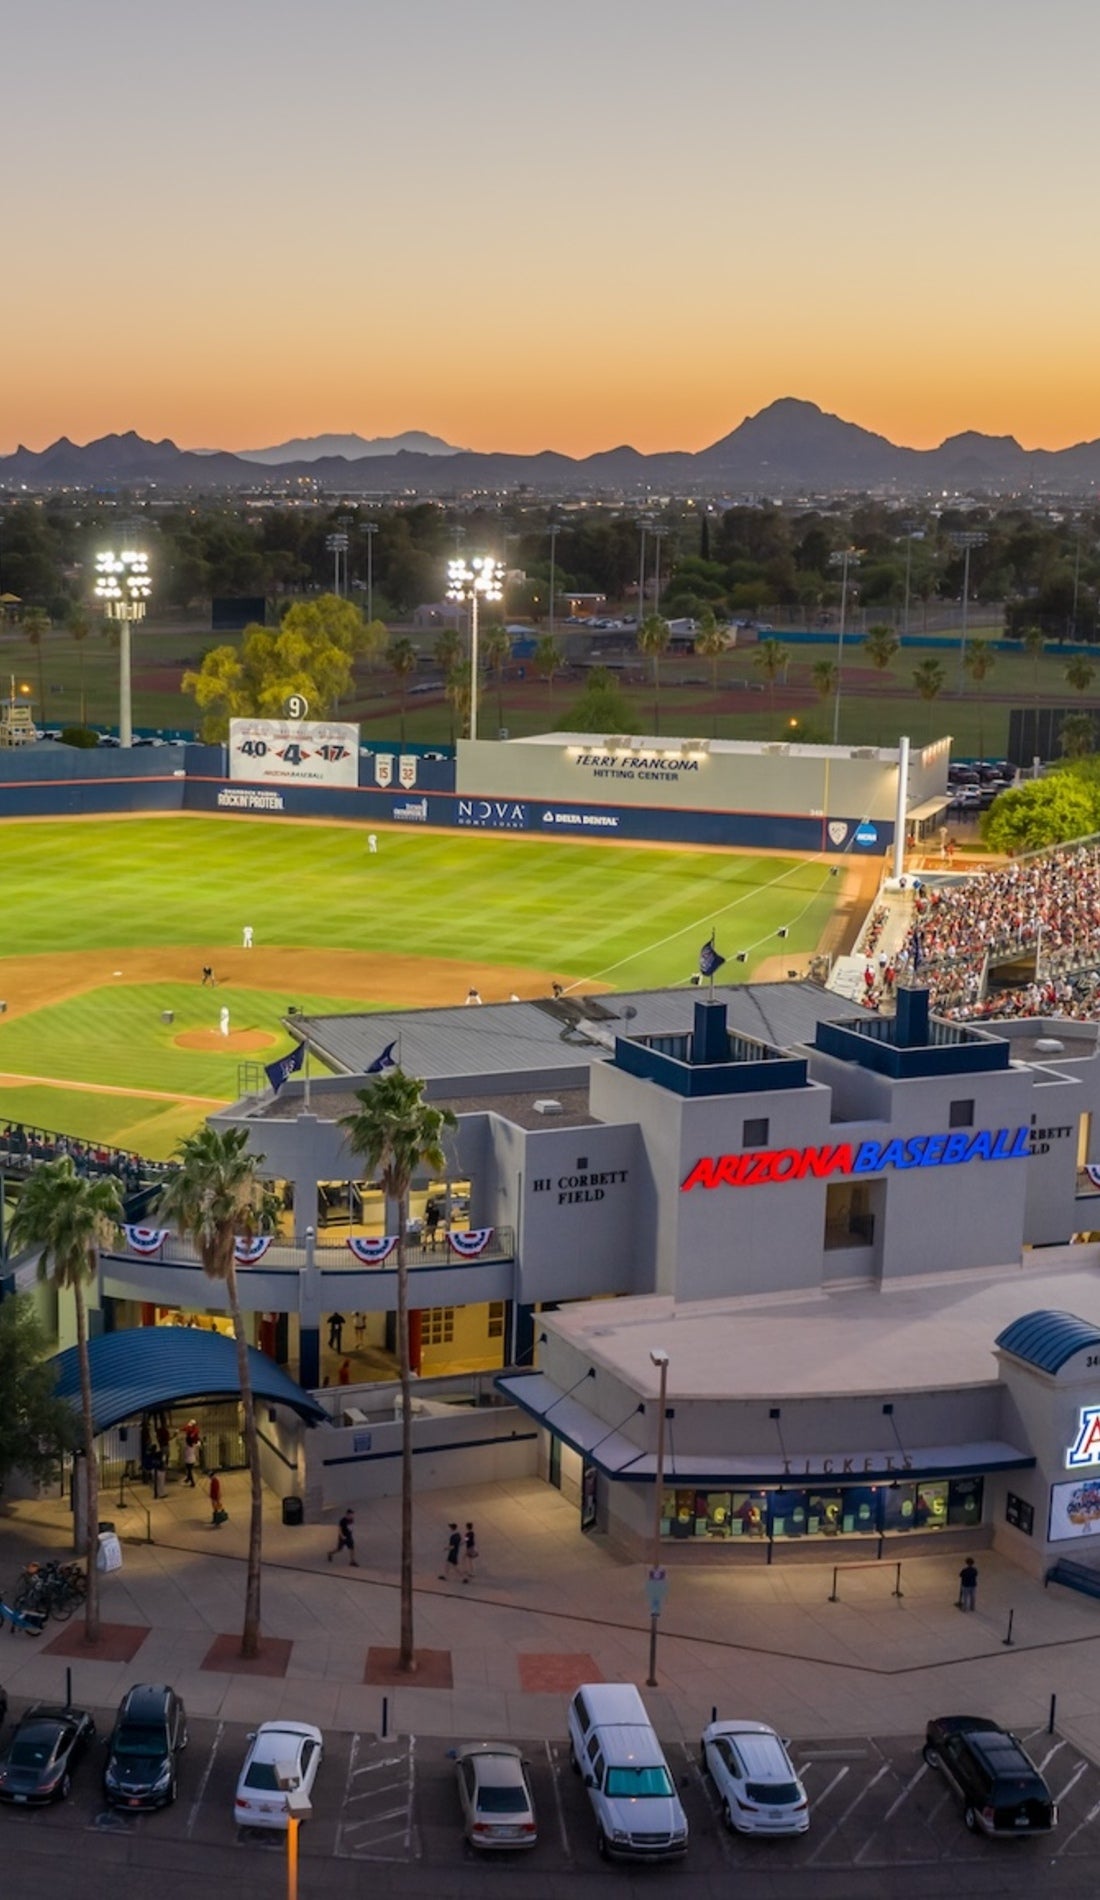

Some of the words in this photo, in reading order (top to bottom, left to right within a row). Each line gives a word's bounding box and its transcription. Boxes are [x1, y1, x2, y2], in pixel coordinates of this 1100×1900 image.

[289, 697, 300, 718] 9
[241, 741, 267, 757] 40
[283, 744, 302, 765] 4
[320, 745, 344, 761] 17
[576, 755, 617, 767] TERRY
[621, 757, 698, 771] FRANCONA
[379, 767, 389, 779] 15
[402, 768, 414, 780] 32
[594, 769, 634, 780] HITTING
[638, 771, 679, 782] CENTER
[458, 800, 524, 820] NOVA
[458, 818, 486, 826] HOME
[555, 813, 582, 824] DELTA
[583, 815, 618, 826] DENTAL
[1030, 1125, 1073, 1141] RBETT
[680, 1143, 854, 1191] ARIZONA
[852, 1126, 1031, 1174] BASEBALL
[533, 1178, 551, 1192] HI
[558, 1169, 628, 1189] CORBETT
[558, 1188, 605, 1205] FIELD
[1086, 1355, 1100, 1368] 34
[782, 1455, 913, 1475] TICKETS
